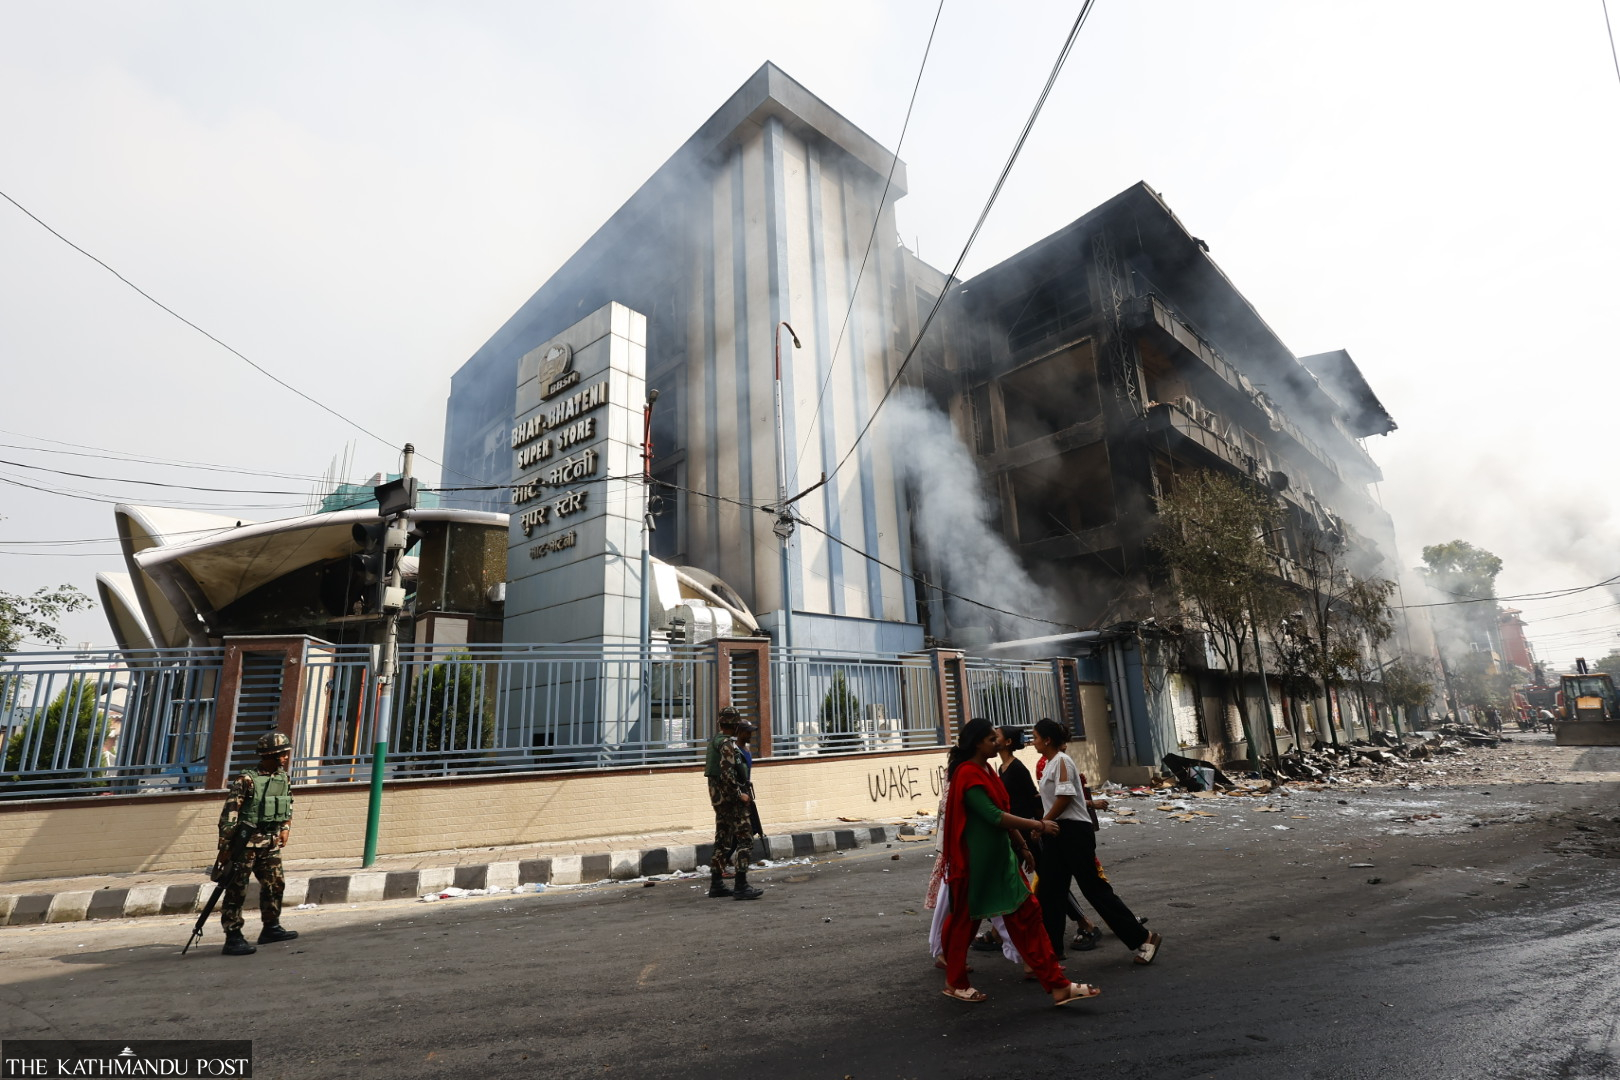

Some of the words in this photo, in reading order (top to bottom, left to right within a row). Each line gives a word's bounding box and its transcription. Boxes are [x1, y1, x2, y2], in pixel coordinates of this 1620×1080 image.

[511, 381, 606, 448] BHAT-BHATENI
[518, 439, 551, 469] SUPER
[557, 417, 593, 450] STORE
[520, 507, 547, 537] सुपर
[554, 490, 586, 518] स्टोर
[868, 765, 921, 802] WAKE
